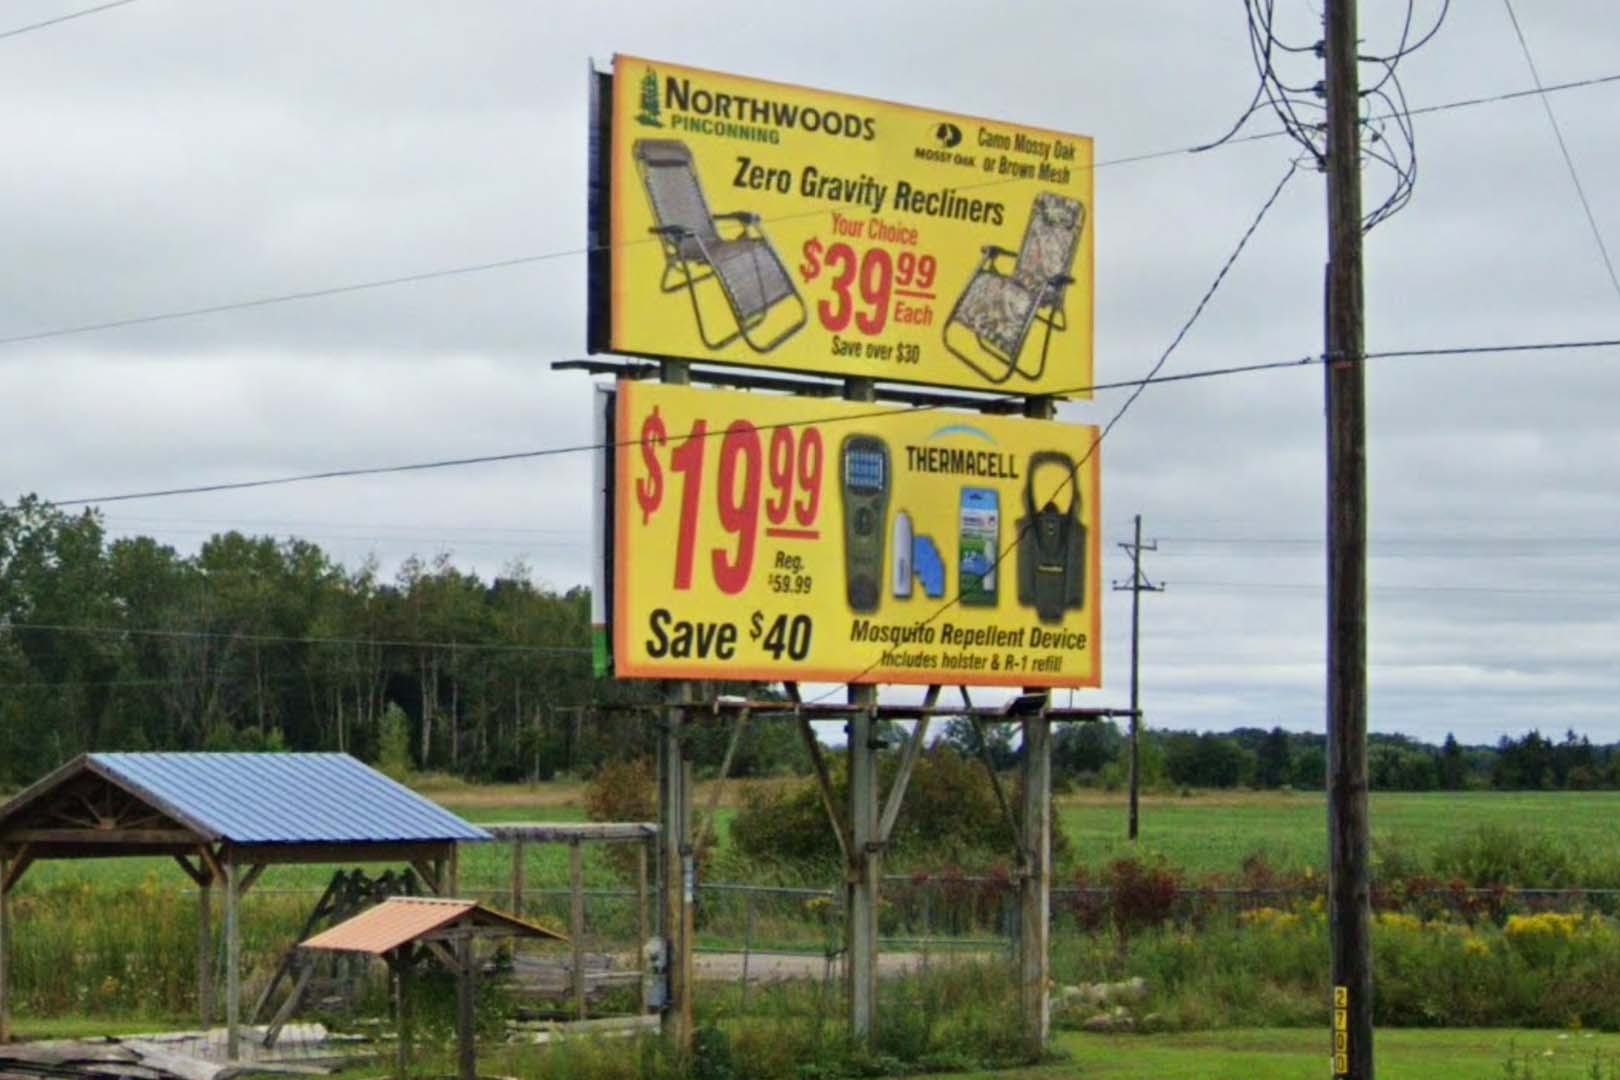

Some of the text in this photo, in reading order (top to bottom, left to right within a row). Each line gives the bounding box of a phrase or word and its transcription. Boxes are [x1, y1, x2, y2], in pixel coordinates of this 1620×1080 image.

[664, 76, 876, 141] NORTHWOODS
[671, 114, 780, 145] PINCONNING
[977, 126, 1076, 160] Camo Mossy Oak
[983, 155, 1070, 184] or Brown Mesh
[732, 156, 1005, 226] Zero Gravity Recliners
[831, 212, 918, 246] Your Choice
[894, 302, 933, 326] Each
[831, 335, 920, 364] Save over $30
[906, 446, 1019, 479] THERMACELL
[775, 551, 805, 574] Reg.
[646, 608, 812, 661] Save $40
[850, 619, 1087, 650] Mosquito Repellent Device
[881, 649, 1063, 673] Includes holster & R-1 refill
